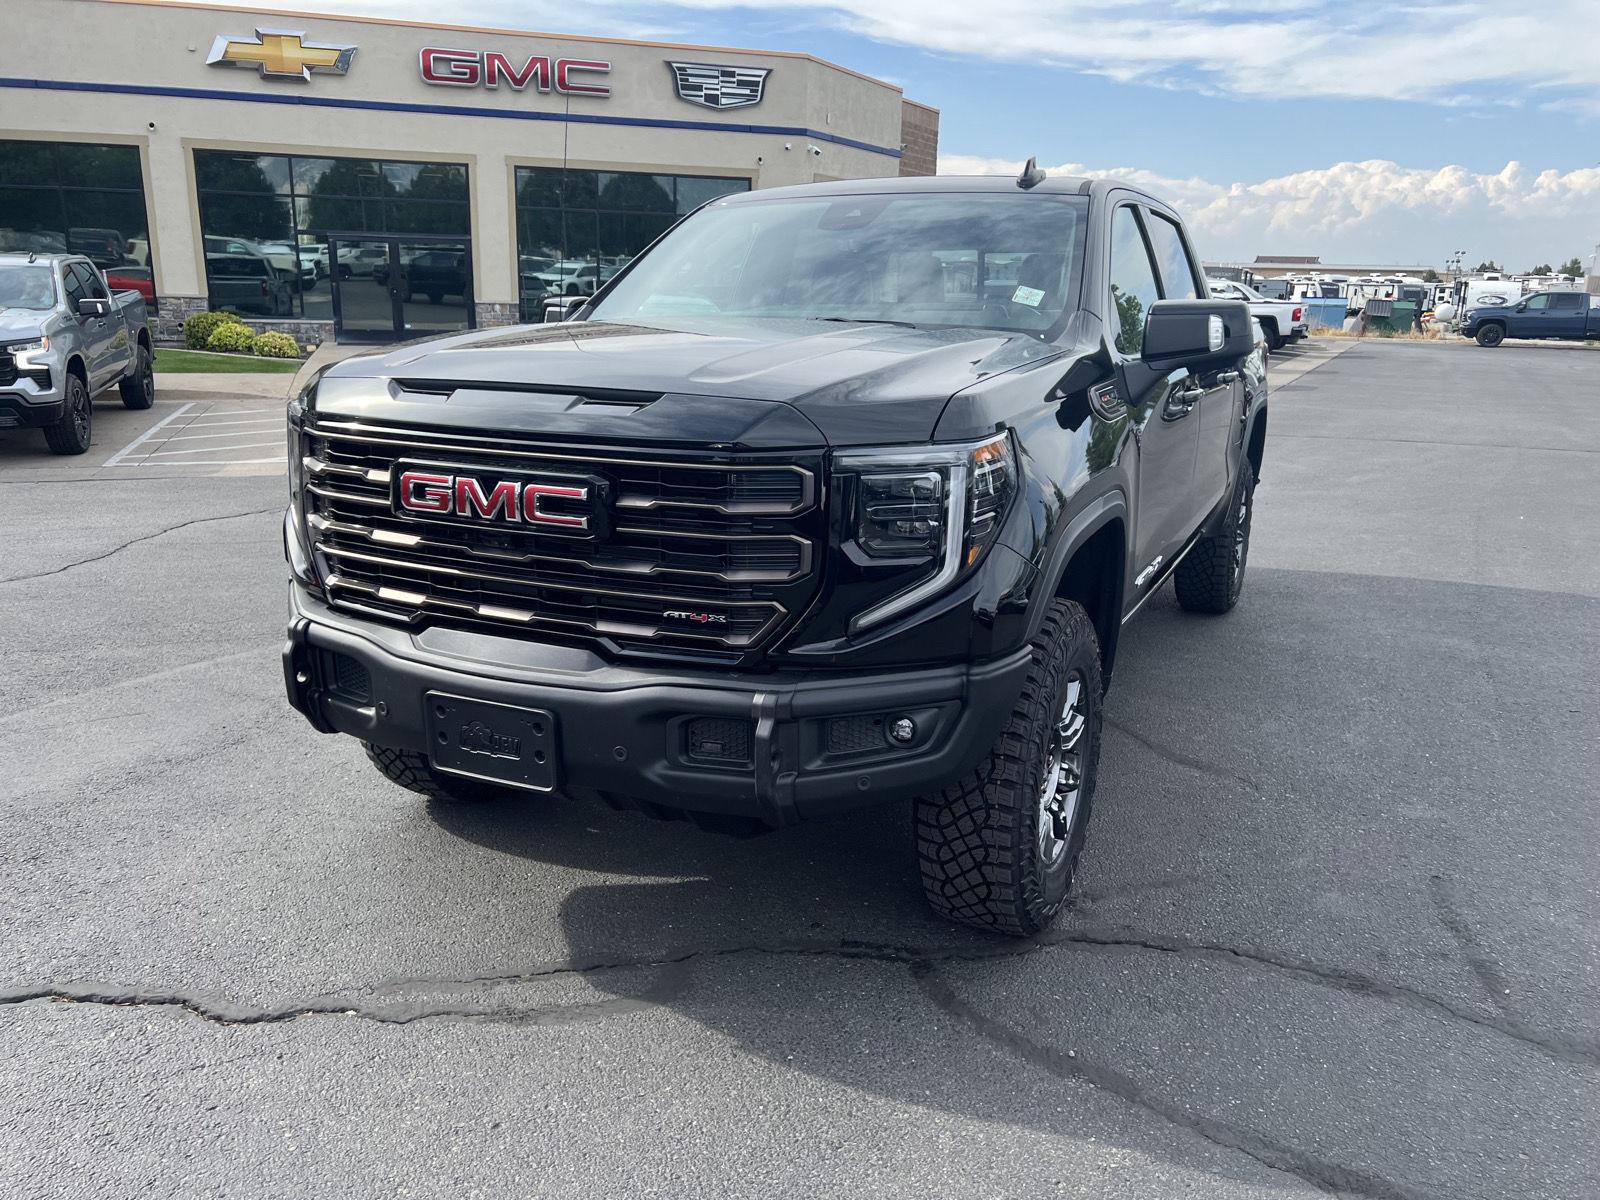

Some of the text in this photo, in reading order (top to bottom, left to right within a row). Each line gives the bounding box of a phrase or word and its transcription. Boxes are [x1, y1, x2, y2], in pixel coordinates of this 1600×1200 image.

[420, 47, 611, 97] GMC
[401, 471, 588, 529] GMC
[663, 610, 726, 623] AT4X
